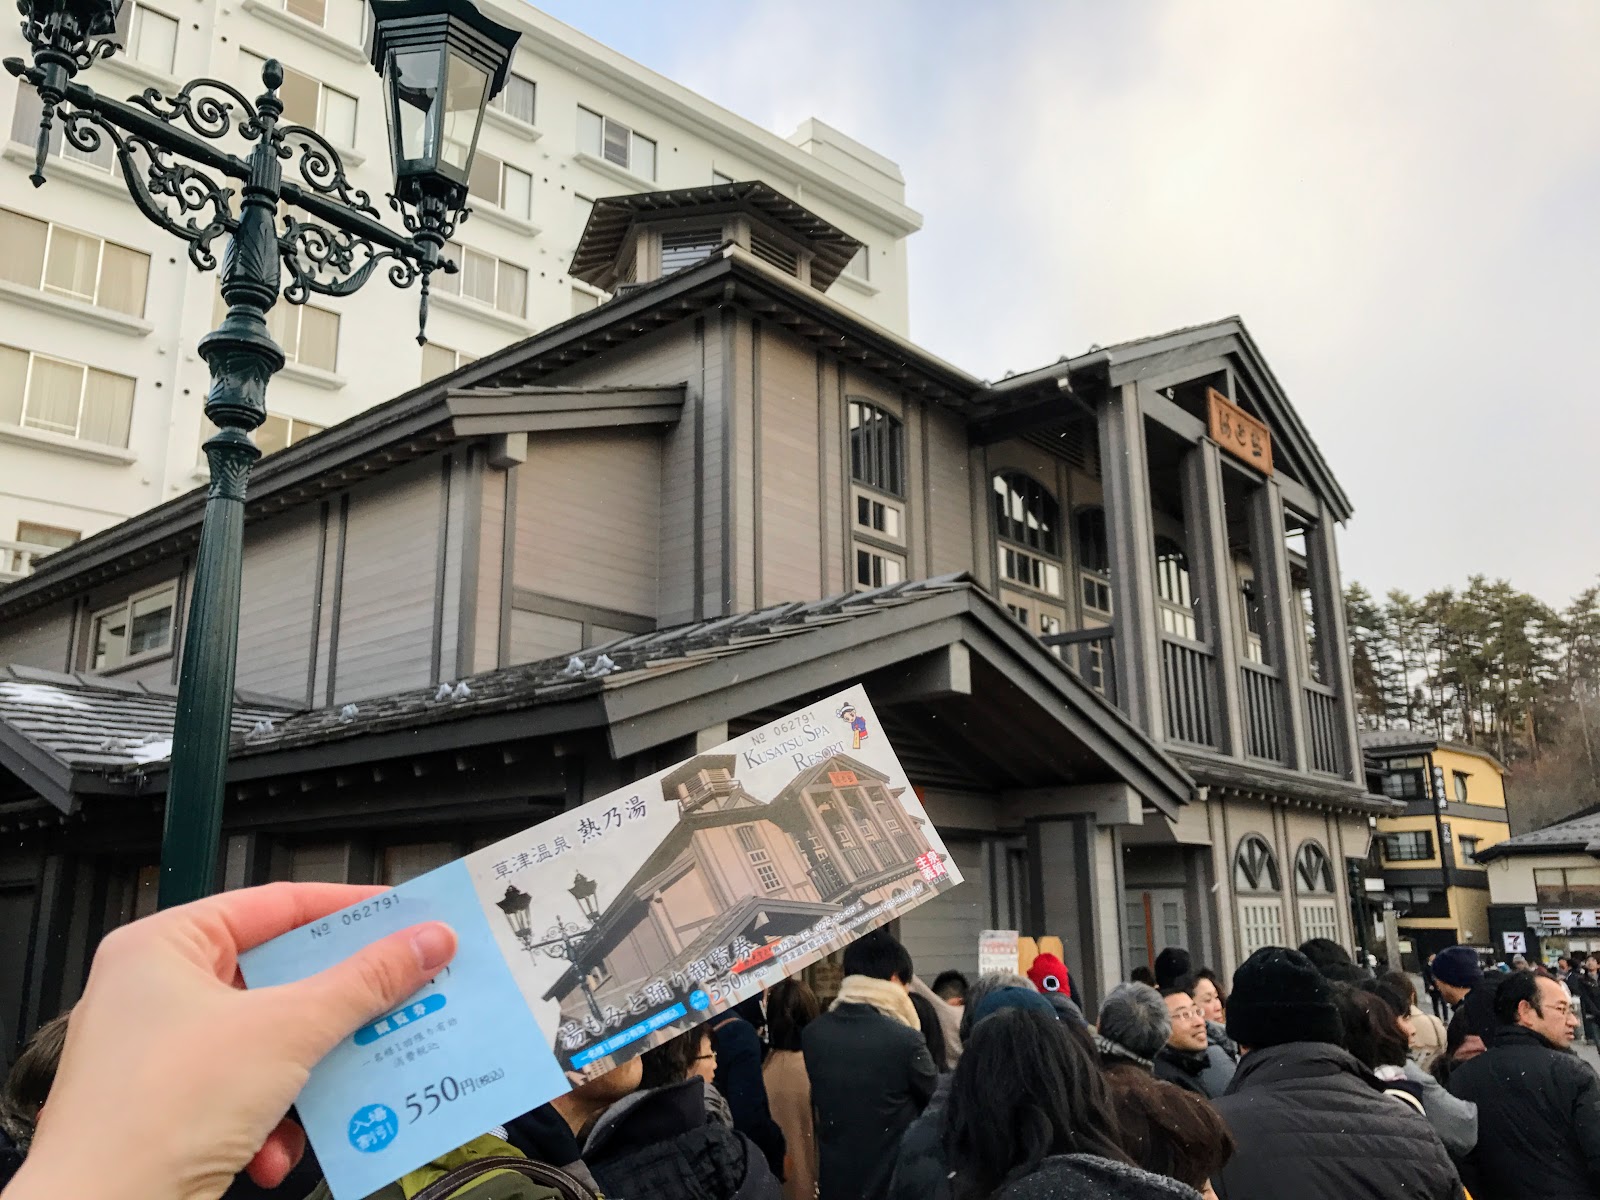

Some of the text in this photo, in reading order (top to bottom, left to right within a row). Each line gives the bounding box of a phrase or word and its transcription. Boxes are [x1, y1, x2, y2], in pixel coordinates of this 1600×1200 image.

[773, 711, 816, 737] 062791
[492, 795, 647, 880] 草津温泉 熱乃湯
[341, 893, 400, 926] 062791
